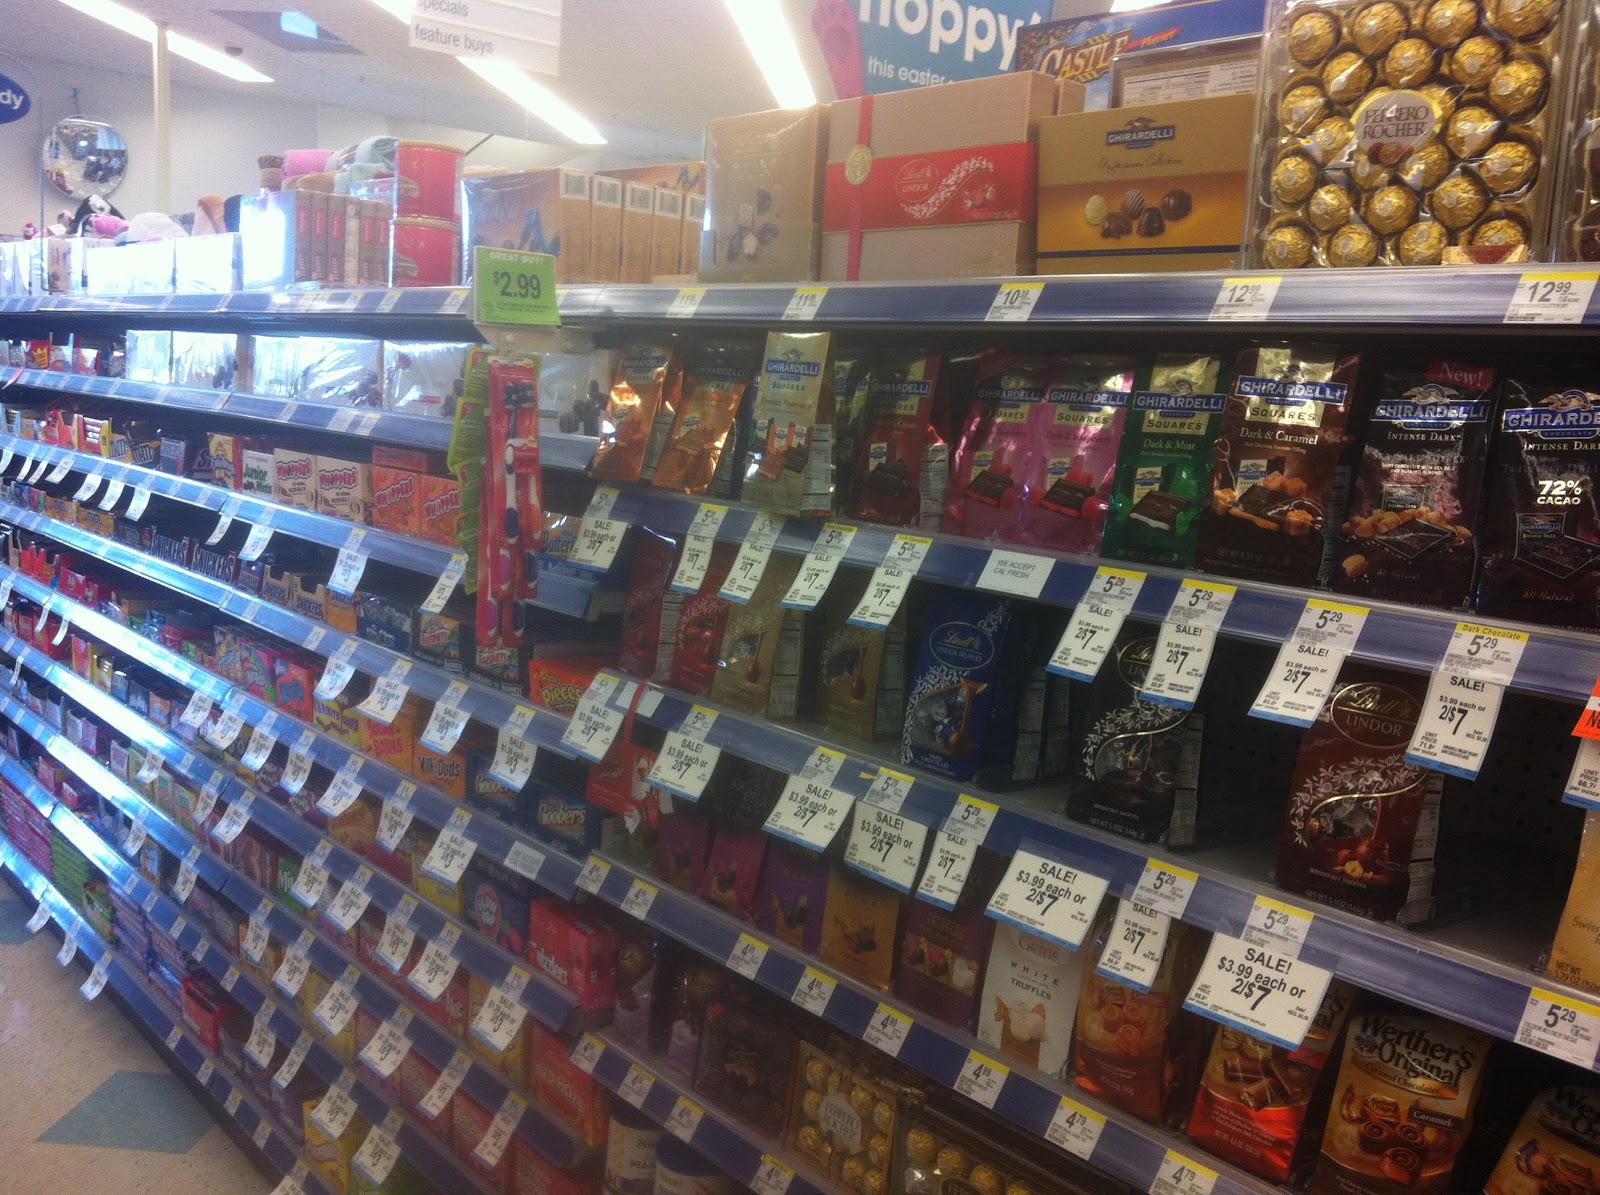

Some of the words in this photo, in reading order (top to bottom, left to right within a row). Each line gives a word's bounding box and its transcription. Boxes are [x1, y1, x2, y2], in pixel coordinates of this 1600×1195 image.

[414, 24, 461, 47] feature
[463, 33, 494, 55] buys
[868, 56, 895, 78] this
[1364, 105, 1430, 124] FERRERO
[1107, 128, 1174, 143] GHIRARDELLI
[1362, 121, 1427, 140] ROCHER
[490, 251, 519, 262] GREAT
[493, 271, 541, 299] $2.99
[767, 361, 819, 376] GHIRARDELLI
[1439, 362, 1484, 387] New!
[772, 381, 805, 392] SQUARES
[871, 381, 930, 394] GHIRARDELLI
[1240, 381, 1342, 401] GHIRARDELLI
[1051, 390, 1128, 406] GHIRARDELLI
[1136, 395, 1223, 410] GHIRARDELLI
[1057, 413, 1109, 425] SQUARES
[1251, 407, 1316, 421] SQUARES
[1375, 404, 1484, 418] GHIRARDELLI
[1147, 419, 1203, 430] SQUARES
[1143, 438, 1164, 450] Dark
[1166, 440, 1173, 449] &
[1240, 427, 1263, 440] Dark
[1264, 430, 1274, 440] &
[1275, 430, 1319, 445] Caramel
[243, 463, 268, 480] Junior
[275, 458, 312, 479] WHOPPERS
[318, 467, 358, 490] WHOPPERS
[1538, 480, 1582, 495] 72%
[1536, 496, 1581, 505] CACAO
[594, 519, 613, 531] SALE!
[814, 555, 832, 563] SALE!
[997, 559, 1009, 567] WE
[1009, 561, 1037, 571] ACCEPT
[884, 568, 903, 578] SALE!
[993, 567, 1006, 575] CAL
[1006, 569, 1030, 579] FRESH
[1088, 605, 1113, 618] SALE!
[1175, 625, 1202, 637] SALE!
[1462, 624, 1481, 634] Dark
[1482, 627, 1521, 641] Chocolate
[1298, 645, 1330, 657] SALE!
[1166, 649, 1189, 675] 2/$7
[1303, 665, 1319, 673] each
[1283, 669, 1312, 694] 2/$7
[1450, 675, 1485, 693] SALE!
[1439, 695, 1458, 706] $3.99
[1459, 701, 1477, 711] each
[590, 705, 609, 720] SALE!
[1439, 704, 1468, 736] 2/$7
[1345, 714, 1403, 737] LINDOR
[681, 739, 704, 753] SALE!
[1421, 735, 1437, 744] PRICE
[667, 746, 685, 760] $3.99
[684, 754, 700, 766] each
[700, 760, 708, 768] or
[438, 758, 461, 778] Duds
[1583, 768, 1599, 777] UNIT
[1579, 772, 1599, 783] PRICE
[805, 783, 833, 801] SALE!
[1581, 788, 1600, 798] ounce
[788, 790, 810, 807] $3.99
[809, 800, 828, 814] each
[827, 808, 838, 817] or
[537, 801, 585, 825] Goobers
[793, 805, 818, 828] 2/$7
[875, 811, 904, 831] SALE!
[861, 819, 882, 837] $3.99
[882, 830, 903, 846] each
[903, 839, 913, 849] or
[946, 833, 968, 847] SALE!
[869, 836, 894, 863] 2/$7
[1038, 862, 1078, 885] SALE!
[1016, 869, 1045, 889] $3.99
[1045, 883, 1072, 900] each
[1073, 893, 1087, 905] or
[1025, 888, 1060, 917] 2/$7
[1132, 902, 1159, 920] SALE!
[1123, 927, 1145, 955] 2/$7
[1244, 947, 1293, 975] SALE!
[1555, 959, 1571, 973] NET
[1570, 964, 1582, 976] WT
[1010, 960, 1060, 986] WHITE
[1217, 956, 1253, 980] $3.99
[1254, 972, 1288, 993] each
[1289, 986, 1306, 999] or
[1010, 977, 1052, 1001] TRUFFLES
[1230, 977, 1272, 1012] 2/$7
[1361, 1016, 1475, 1071] Werther's
[1378, 1040, 1465, 1088] Original
[1365, 1062, 1399, 1082] Caramel
[1399, 1078, 1440, 1095] Chocolates
[1413, 1110, 1452, 1127] Caramel
